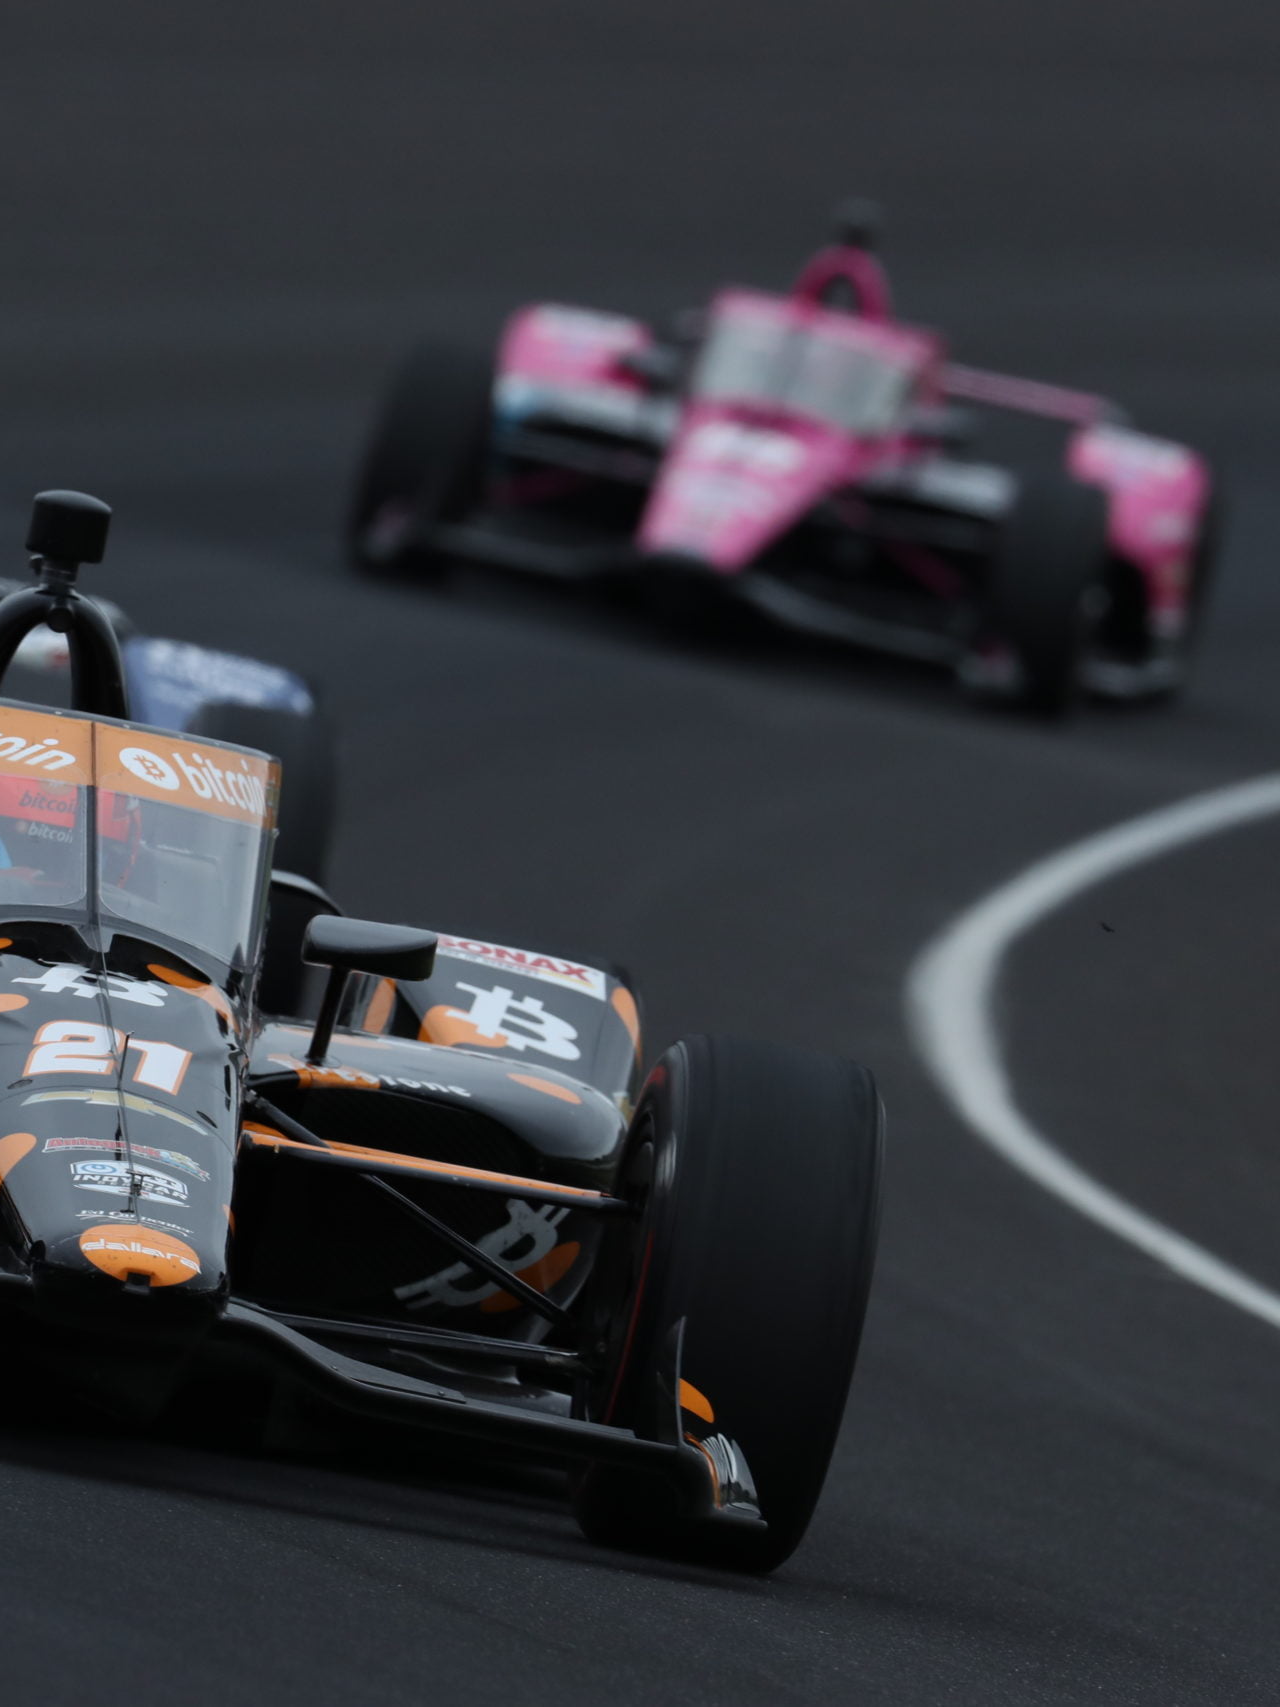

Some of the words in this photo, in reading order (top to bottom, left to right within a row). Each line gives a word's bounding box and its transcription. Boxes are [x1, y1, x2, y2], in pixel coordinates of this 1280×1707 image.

[172, 752, 267, 817] bitcoin
[23, 1019, 194, 1095] 21
[81, 1238, 202, 1275] dallara
